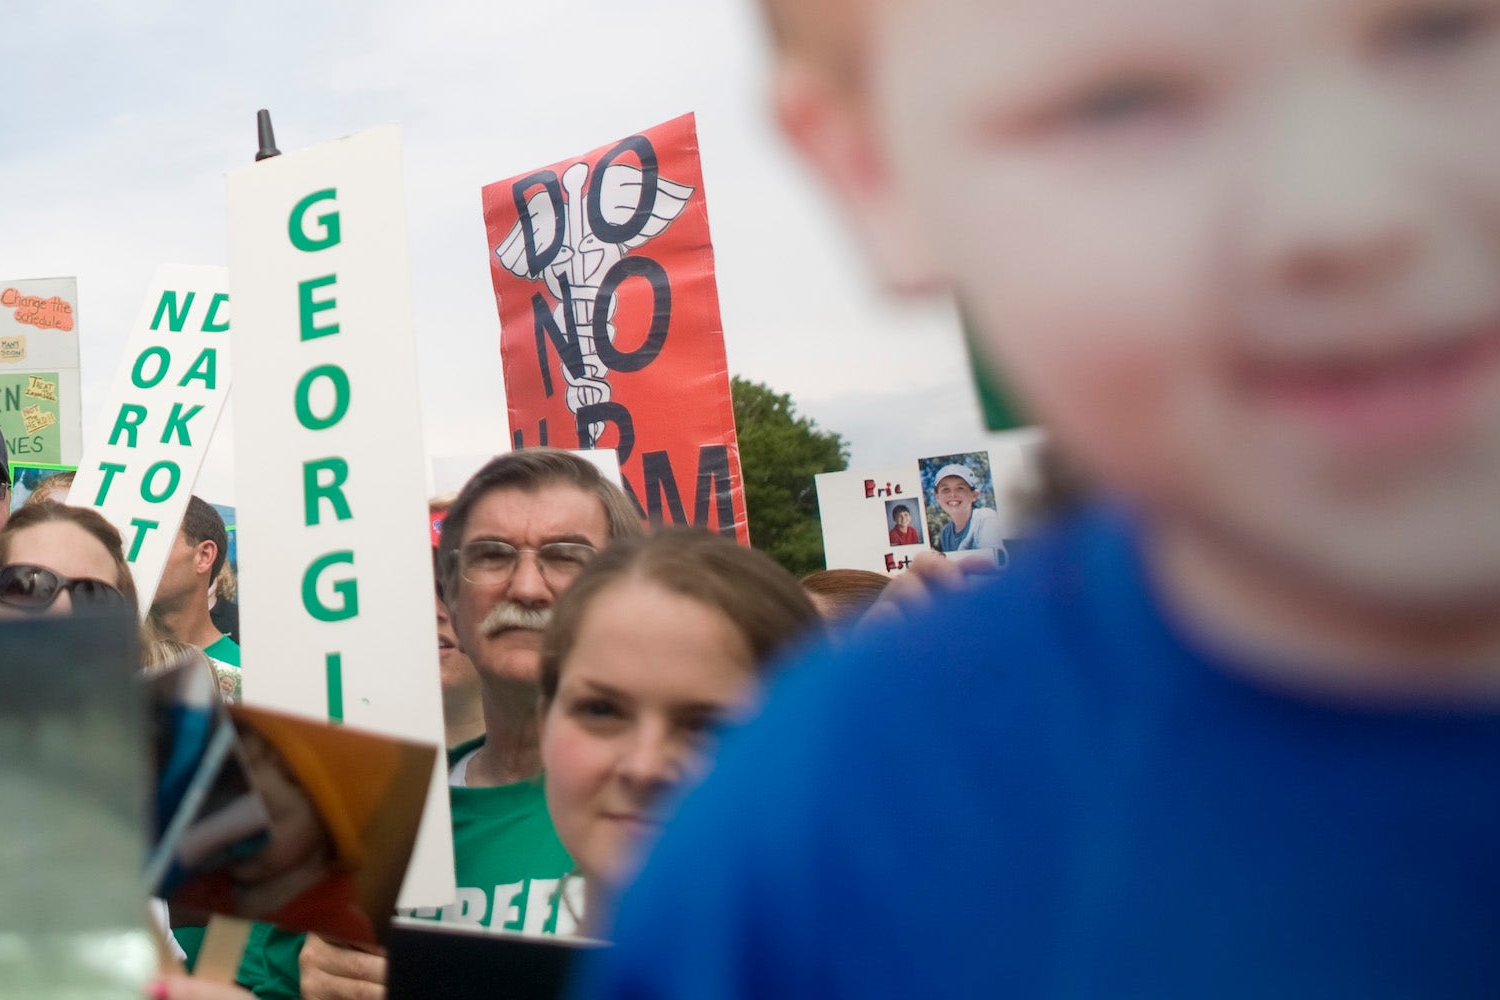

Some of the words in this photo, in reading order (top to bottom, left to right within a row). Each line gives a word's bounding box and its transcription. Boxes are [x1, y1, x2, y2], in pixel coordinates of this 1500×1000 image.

[512, 134, 659, 277] DO
[0, 288, 47, 315] Change
[531, 255, 672, 398] NO
[93, 290, 196, 507] NORT
[287, 188, 360, 725] GEORGI
[397, 872, 585, 939] REE
